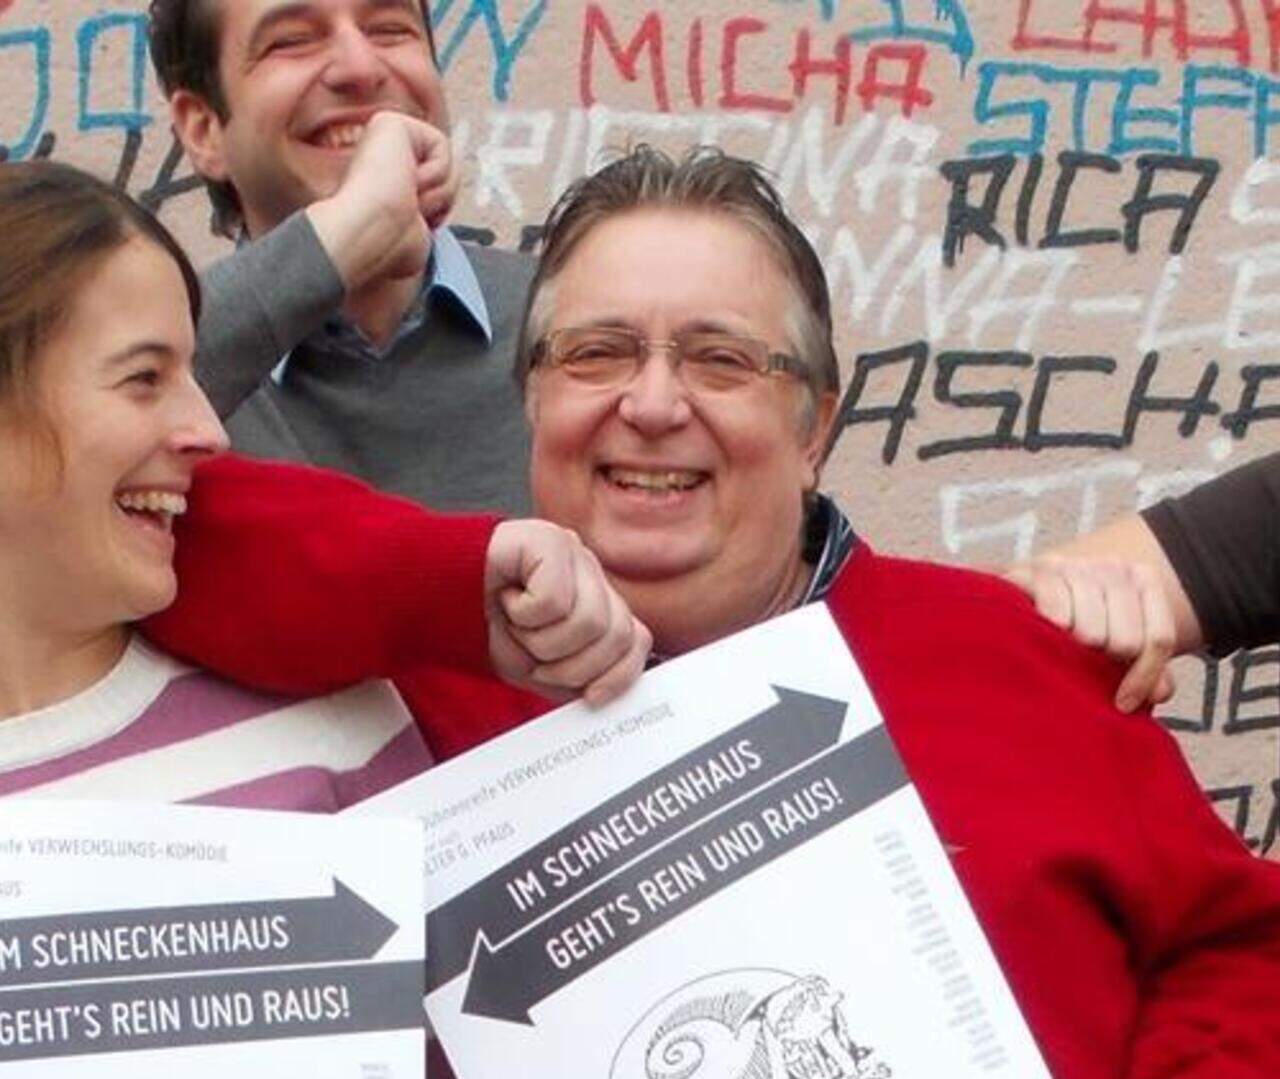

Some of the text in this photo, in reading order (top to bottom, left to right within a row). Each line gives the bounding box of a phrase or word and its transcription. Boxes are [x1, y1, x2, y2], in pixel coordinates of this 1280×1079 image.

[578, 4, 933, 124] MICHA
[940, 150, 1222, 268] RICA
[505, 738, 763, 913] IM SCHNECKENHAUS
[545, 776, 845, 970] GEHT'S REIN UND RAUS!
[32, 915, 290, 968] SCHNECKENHAUS
[113, 999, 181, 1036] REIN
[191, 994, 254, 1030] UND
[263, 986, 352, 1025] RAUS!
